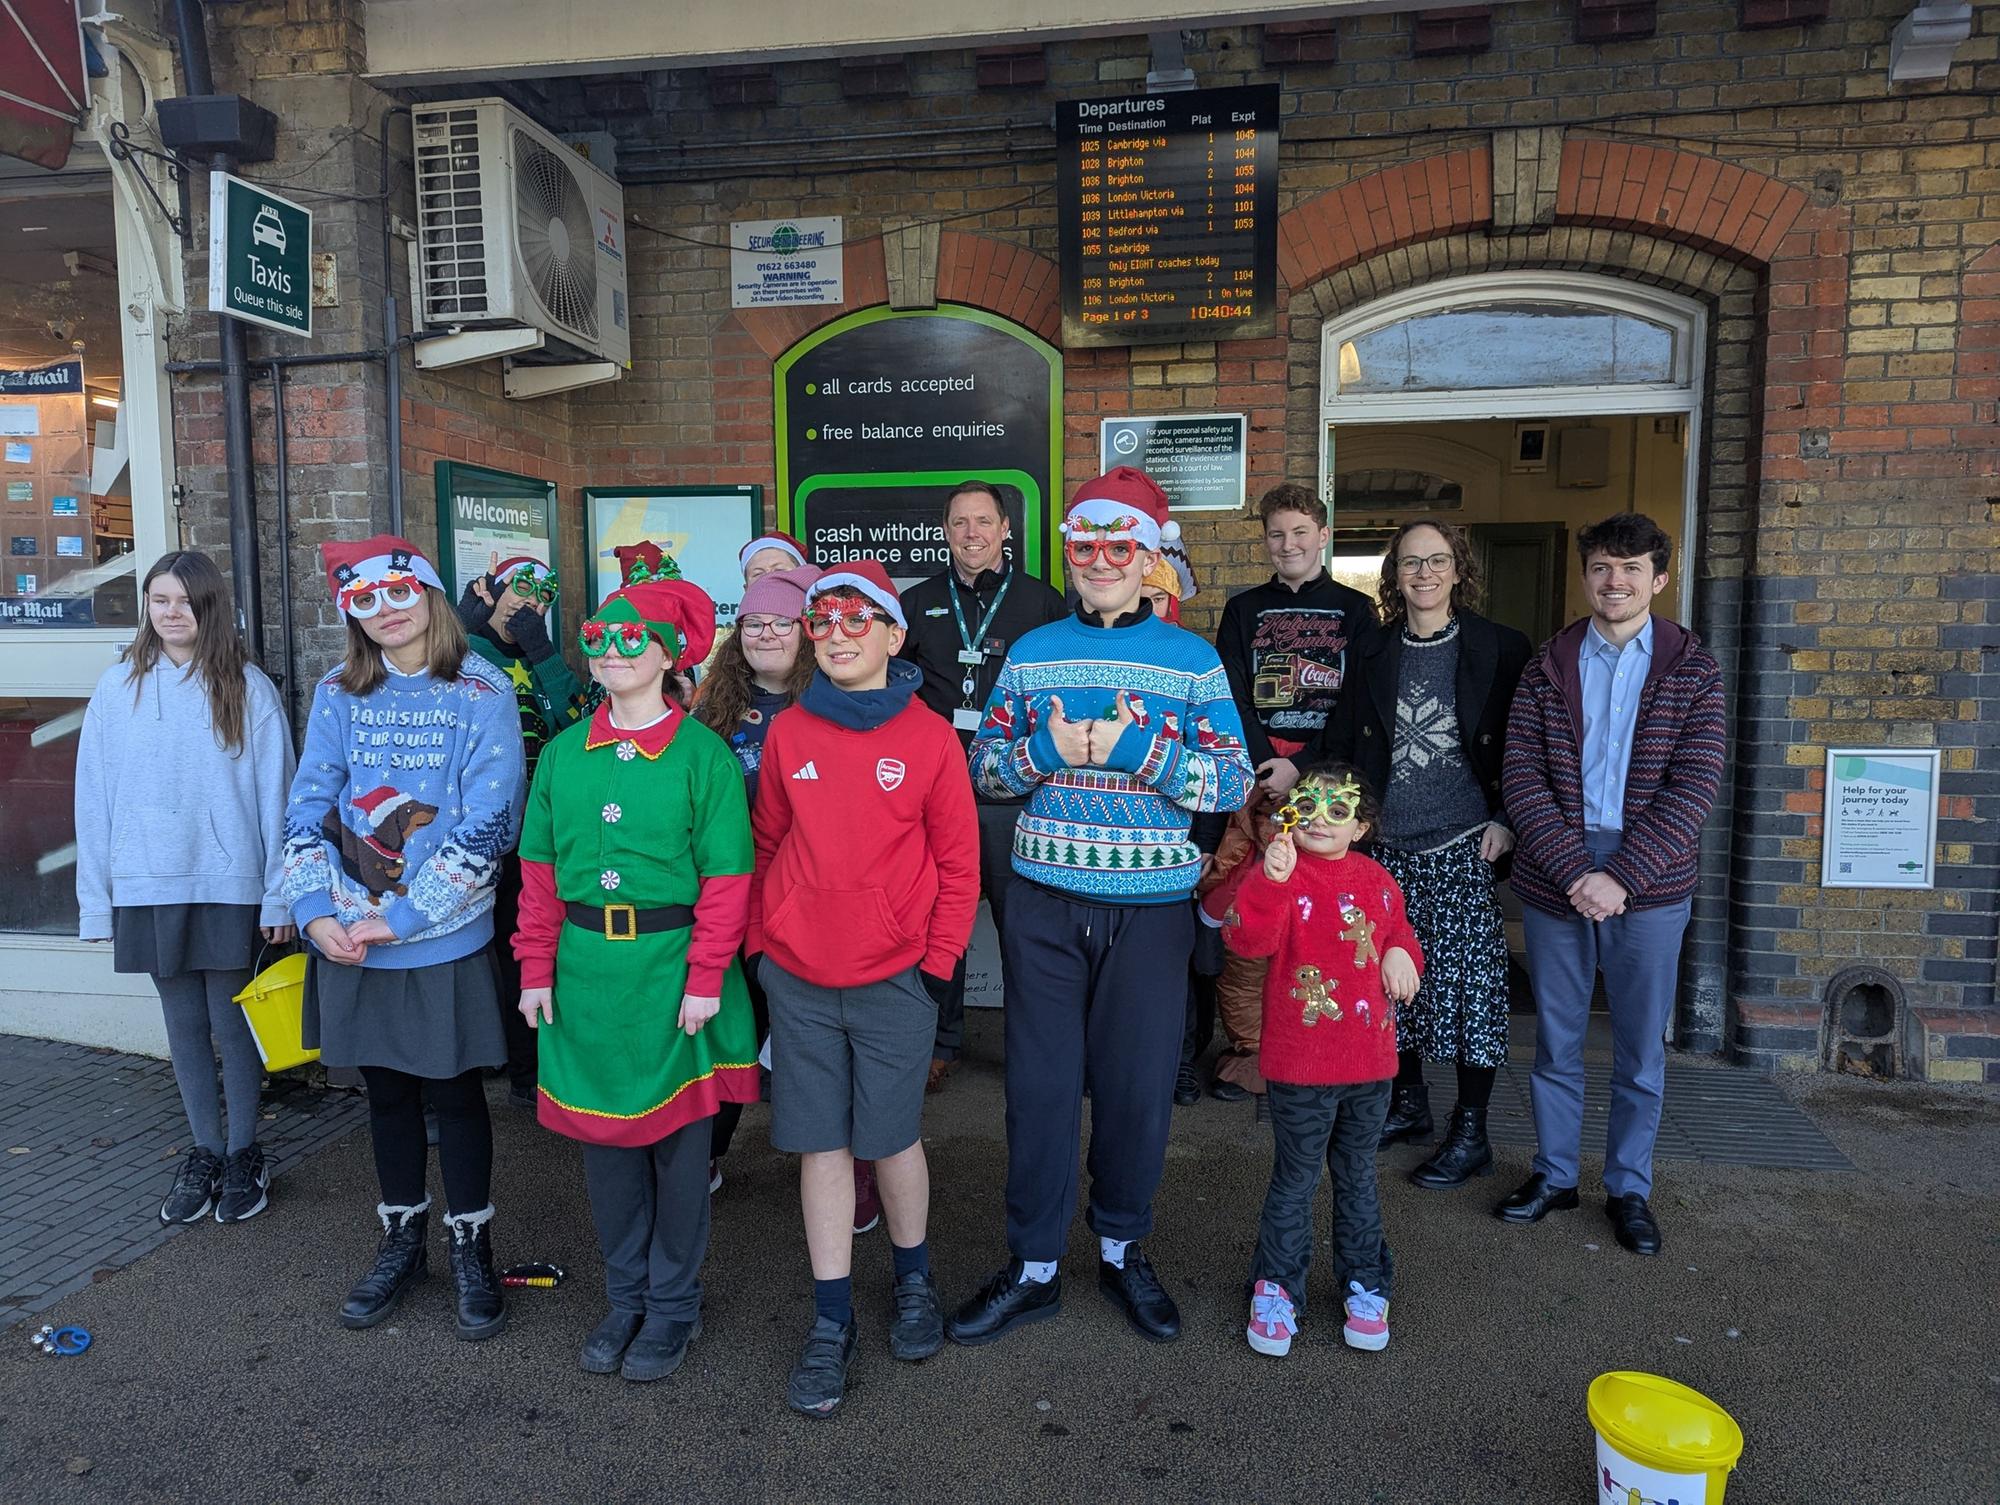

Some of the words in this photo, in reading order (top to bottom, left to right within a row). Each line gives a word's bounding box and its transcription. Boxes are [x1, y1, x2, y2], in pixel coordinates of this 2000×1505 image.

[1079, 99, 1166, 119] Departures
[1078, 124, 1103, 134] Time
[1108, 119, 1166, 132] Destination
[1191, 115, 1212, 125] Plat
[1231, 111, 1256, 123] Expt
[1081, 141, 1100, 152] 1025
[1107, 138, 1150, 151] Cambridge
[1153, 136, 1167, 147] via
[1208, 132, 1213, 143] 1
[1235, 129, 1255, 141] 1045
[1081, 159, 1100, 170] 1028
[1107, 157, 1144, 169] Brighton
[1207, 150, 1214, 161] 2
[1235, 148, 1255, 159] 1044
[1107, 174, 1144, 187] Brighton
[1207, 168, 1214, 178] 2
[1235, 165, 1255, 176] 1055
[1082, 193, 1101, 204] 1036
[1108, 192, 1138, 203] London
[1140, 189, 1175, 201] Victoria
[1208, 186, 1213, 197] 1
[1234, 183, 1255, 194] 1044
[262, 204, 278, 218] TAXI
[1082, 210, 1101, 222] 1039
[1108, 207, 1168, 220] Littlehampton
[1171, 207, 1185, 217] via
[1207, 203, 1214, 214] 2
[1234, 201, 1254, 212] 1101
[1082, 227, 1101, 239] 1042
[1108, 226, 1143, 237] Bedford
[1145, 226, 1159, 235] via
[1208, 221, 1213, 231] 1
[1234, 218, 1254, 229] 1053
[1083, 244, 1101, 256] 1055
[1108, 243, 1150, 255] Cambridge
[247, 253, 292, 294] Taxis
[757, 262, 782, 272] 01622
[784, 260, 817, 270] 663480
[1109, 261, 1128, 273] Only
[1130, 258, 1155, 270] EIGHT
[1157, 257, 1192, 268] coaches
[1195, 256, 1220, 268] today
[737, 282, 761, 290] Security
[762, 280, 788, 289] Cameras
[807, 279, 838, 287] operation
[762, 271, 811, 281] WARNING
[1083, 278, 1102, 289] 1058
[1109, 276, 1145, 289] Brighton
[1207, 271, 1213, 282] 2
[1234, 270, 1254, 281] 1104
[750, 295, 775, 303] 24-hour
[794, 293, 825, 301] Recording
[779, 287, 807, 296] premises
[1083, 295, 1102, 306] 1106
[1109, 294, 1138, 305] London
[1140, 291, 1175, 303] Victoria
[1208, 289, 1213, 300] 1
[1221, 288, 1232, 299] On
[1235, 287, 1253, 298] time
[233, 286, 265, 309] Queue
[266, 297, 284, 315] this
[285, 303, 303, 321] side
[1083, 312, 1110, 324] Page
[1113, 311, 1119, 321] 1
[1124, 310, 1137, 320] of
[1141, 309, 1149, 319] 3
[1191, 304, 1251, 319] 10:40:44
[27, 367, 69, 386] Mail
[822, 377, 841, 395] all
[848, 376, 892, 394] cards
[900, 374, 975, 395] accepted
[822, 423, 853, 440] free
[861, 421, 924, 440] balance
[932, 420, 1006, 441] enquiries
[1145, 427, 1157, 435] For
[1157, 428, 1172, 436] your
[1172, 426, 1200, 436] personal
[1200, 425, 1220, 435] safety
[1220, 425, 1234, 433] and
[1145, 437, 1174, 445] security,
[1174, 437, 1203, 445] cameras
[1203, 435, 1234, 443] maintain
[1145, 446, 1174, 454] recorded
[1174, 445, 1213, 454] surveillance
[1213, 444, 1221, 452] of
[1221, 444, 1233, 452] the
[1145, 456, 1169, 464] station.
[1170, 455, 1190, 463] CCTV
[1190, 454, 1220, 462] evidence
[1145, 465, 1155, 473] be
[1154, 465, 1171, 473] used
[1184, 464, 1202, 472] court
[457, 495, 529, 526] Welcome
[814, 523, 863, 543] cash
[869, 522, 946, 542] withdra
[815, 544, 902, 564] balance
[22, 601, 64, 618] Mail
[1256, 613, 1342, 637] Holidays
[1274, 630, 1348, 653] Coming
[390, 752, 446, 771] SNOW
[1841, 796, 1879, 805] journey
[1881, 796, 1909, 805] today
[1843, 786, 1866, 795] Help
[1868, 786, 1883, 794] for
[1885, 787, 1907, 796] your
